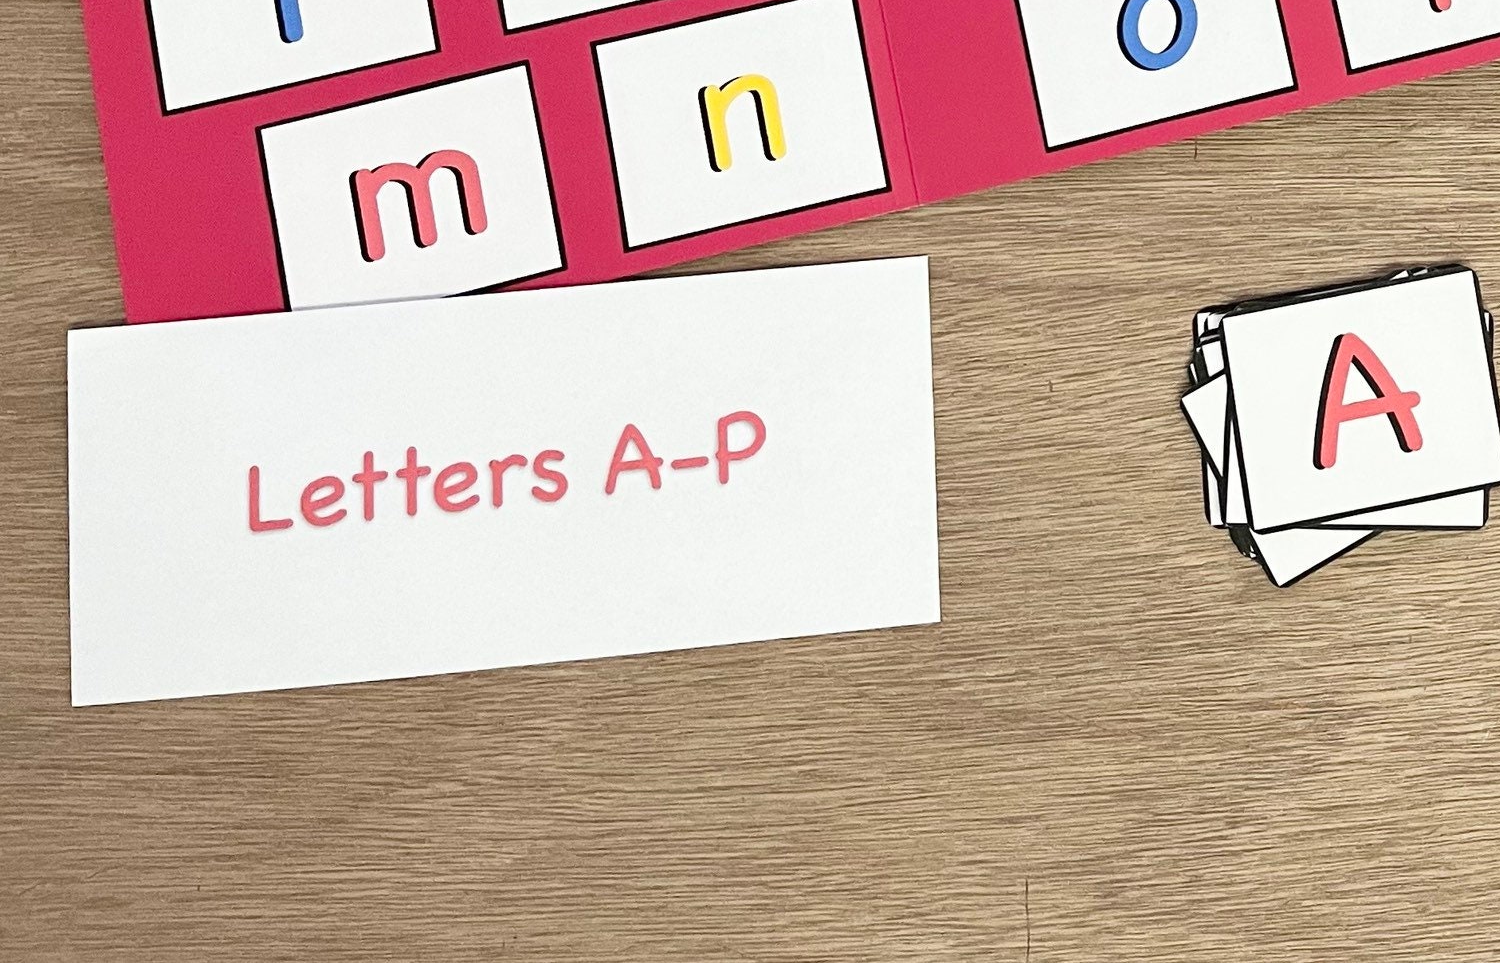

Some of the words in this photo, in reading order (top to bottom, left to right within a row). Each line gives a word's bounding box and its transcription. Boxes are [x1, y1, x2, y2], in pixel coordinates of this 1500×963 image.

[698, 73, 787, 172] n
[349, 149, 488, 262] m
[1313, 333, 1423, 470] A
[248, 447, 568, 533] Letters
[605, 411, 766, 495] A-P
